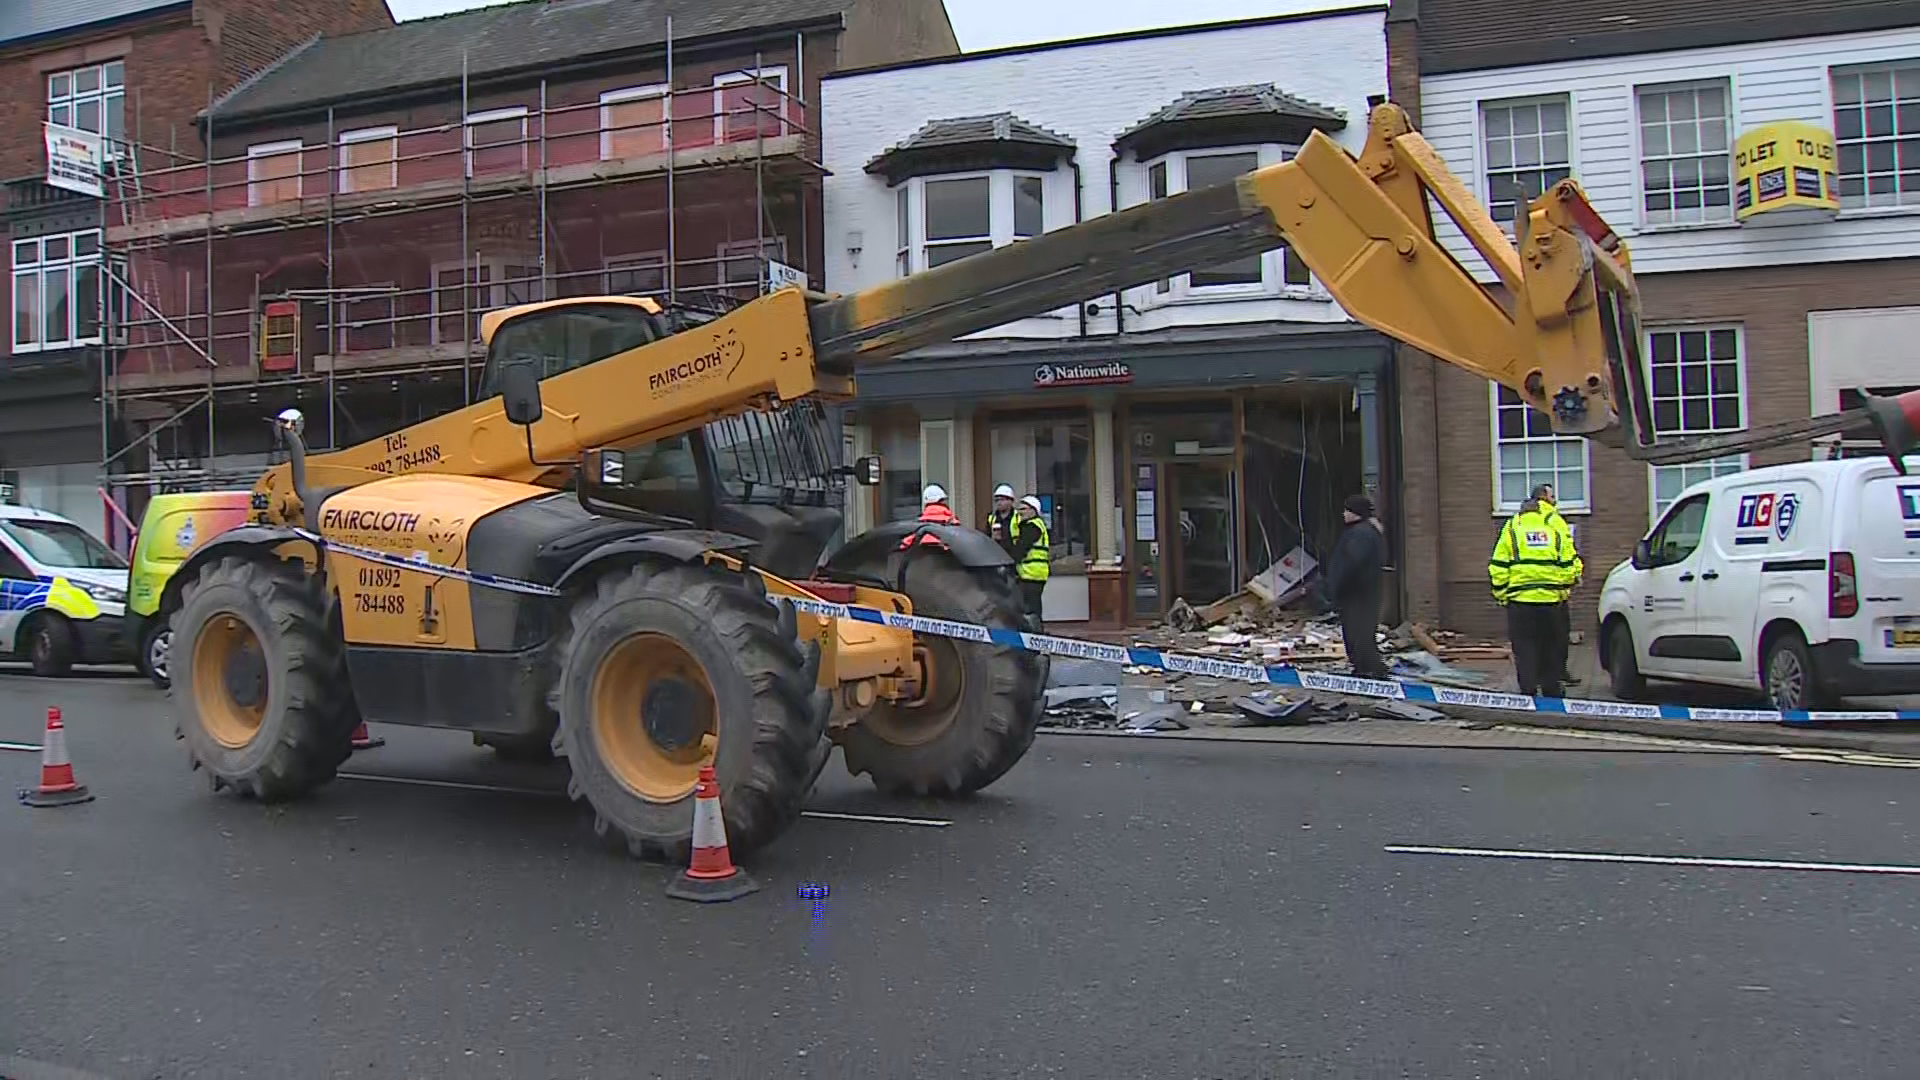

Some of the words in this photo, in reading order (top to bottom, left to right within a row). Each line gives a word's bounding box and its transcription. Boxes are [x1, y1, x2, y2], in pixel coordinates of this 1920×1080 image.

[1750, 140, 1777, 163] LET
[1796, 139, 1814, 156] TO
[649, 352, 721, 390] FAIRCLOTH
[1055, 363, 1129, 379] Nationwide
[384, 434, 407, 453] Tel:
[395, 444, 441, 472] 784488
[323, 509, 421, 532] FAIRCLOTH
[359, 568, 400, 588] 01892
[355, 594, 405, 614] 784488
[960, 625, 985, 638] POLICE
[1100, 647, 1124, 660] POLICE
